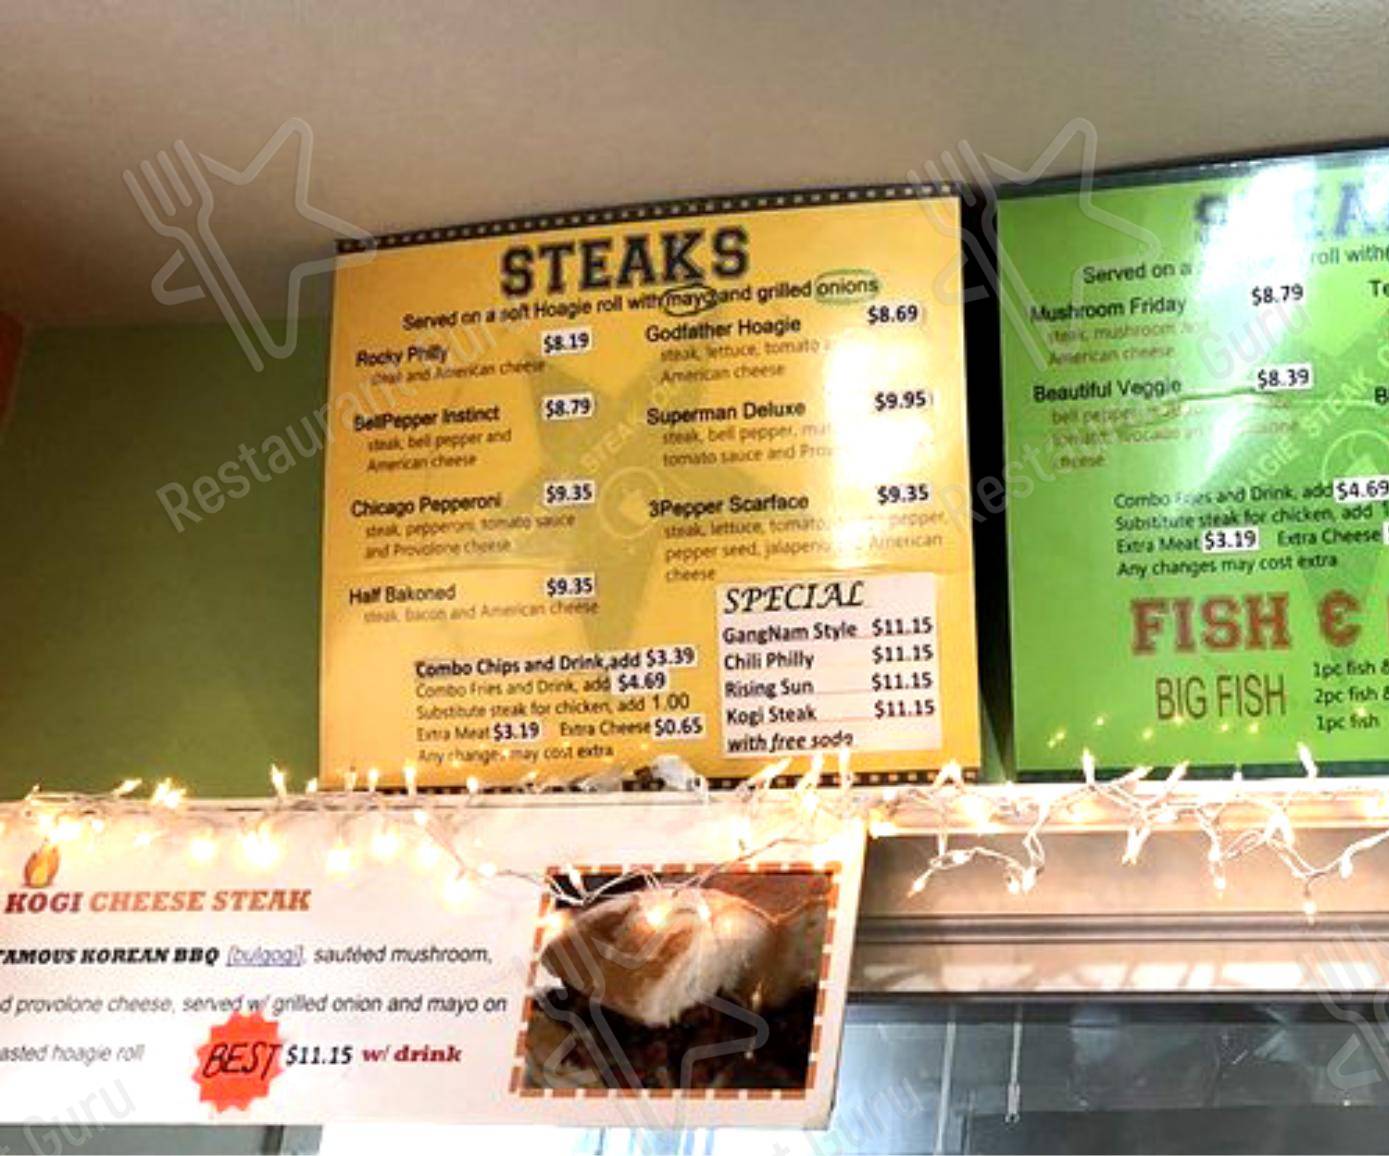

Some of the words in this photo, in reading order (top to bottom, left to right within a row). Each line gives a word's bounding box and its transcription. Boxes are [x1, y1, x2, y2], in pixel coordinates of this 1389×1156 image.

[501, 226, 749, 297] STEAKS
[1252, 284, 1303, 305] $8.79
[868, 305, 917, 325] $8.69
[1031, 301, 1124, 322] Mushroom
[1129, 298, 1186, 316] Friday
[646, 318, 731, 342] Godfather
[739, 317, 801, 337] Hoagie
[1257, 369, 1309, 388] $8.39
[875, 391, 927, 411] $9.95
[1032, 383, 1111, 402] Beautiful
[353, 412, 436, 432] BellPepper
[442, 406, 500, 423] Instinct
[546, 399, 590, 418] $8.79
[647, 402, 737, 426] Superman
[743, 400, 806, 418] Deluxe
[877, 485, 928, 505] $9.35
[649, 500, 723, 521] 3Pepper
[730, 495, 809, 513] Scarface
[547, 577, 592, 595] $9.35
[724, 581, 864, 614] SPECIAL
[723, 625, 809, 646] GangNam
[813, 622, 857, 642] Style
[872, 618, 932, 636] $11.15
[1131, 593, 1291, 655] FISH
[416, 660, 472, 679] Combo
[477, 656, 520, 677] Chips
[524, 656, 555, 672] and
[645, 647, 695, 666] $3.39
[724, 654, 761, 670] Chili
[766, 651, 814, 670] Philly
[872, 645, 933, 665] $11.15
[1314, 663, 1342, 678] 1pc
[1346, 660, 1375, 676] fish
[724, 681, 776, 698] Rising
[780, 681, 814, 695] Sun
[872, 673, 932, 692] $11.15
[1156, 676, 1206, 720] BIG
[1216, 674, 1286, 717] FISH
[1314, 690, 1343, 705] 2pc
[1348, 686, 1377, 702] fish
[726, 707, 764, 726] Kogi
[769, 705, 817, 722] Steak
[874, 700, 935, 718] $11.15
[4, 893, 83, 913] KOGI
[89, 891, 201, 912] CHEESE
[212, 890, 312, 912] STEAK
[80, 947, 169, 963] KOREAN
[174, 947, 219, 965] BBQ
[273, 993, 327, 1016] grilled
[333, 995, 383, 1012] onion
[388, 994, 423, 1012] and
[427, 995, 477, 1016] mayo
[202, 1043, 282, 1079] BEST
[285, 1046, 351, 1066] $11.15
[394, 1046, 461, 1063] drink
